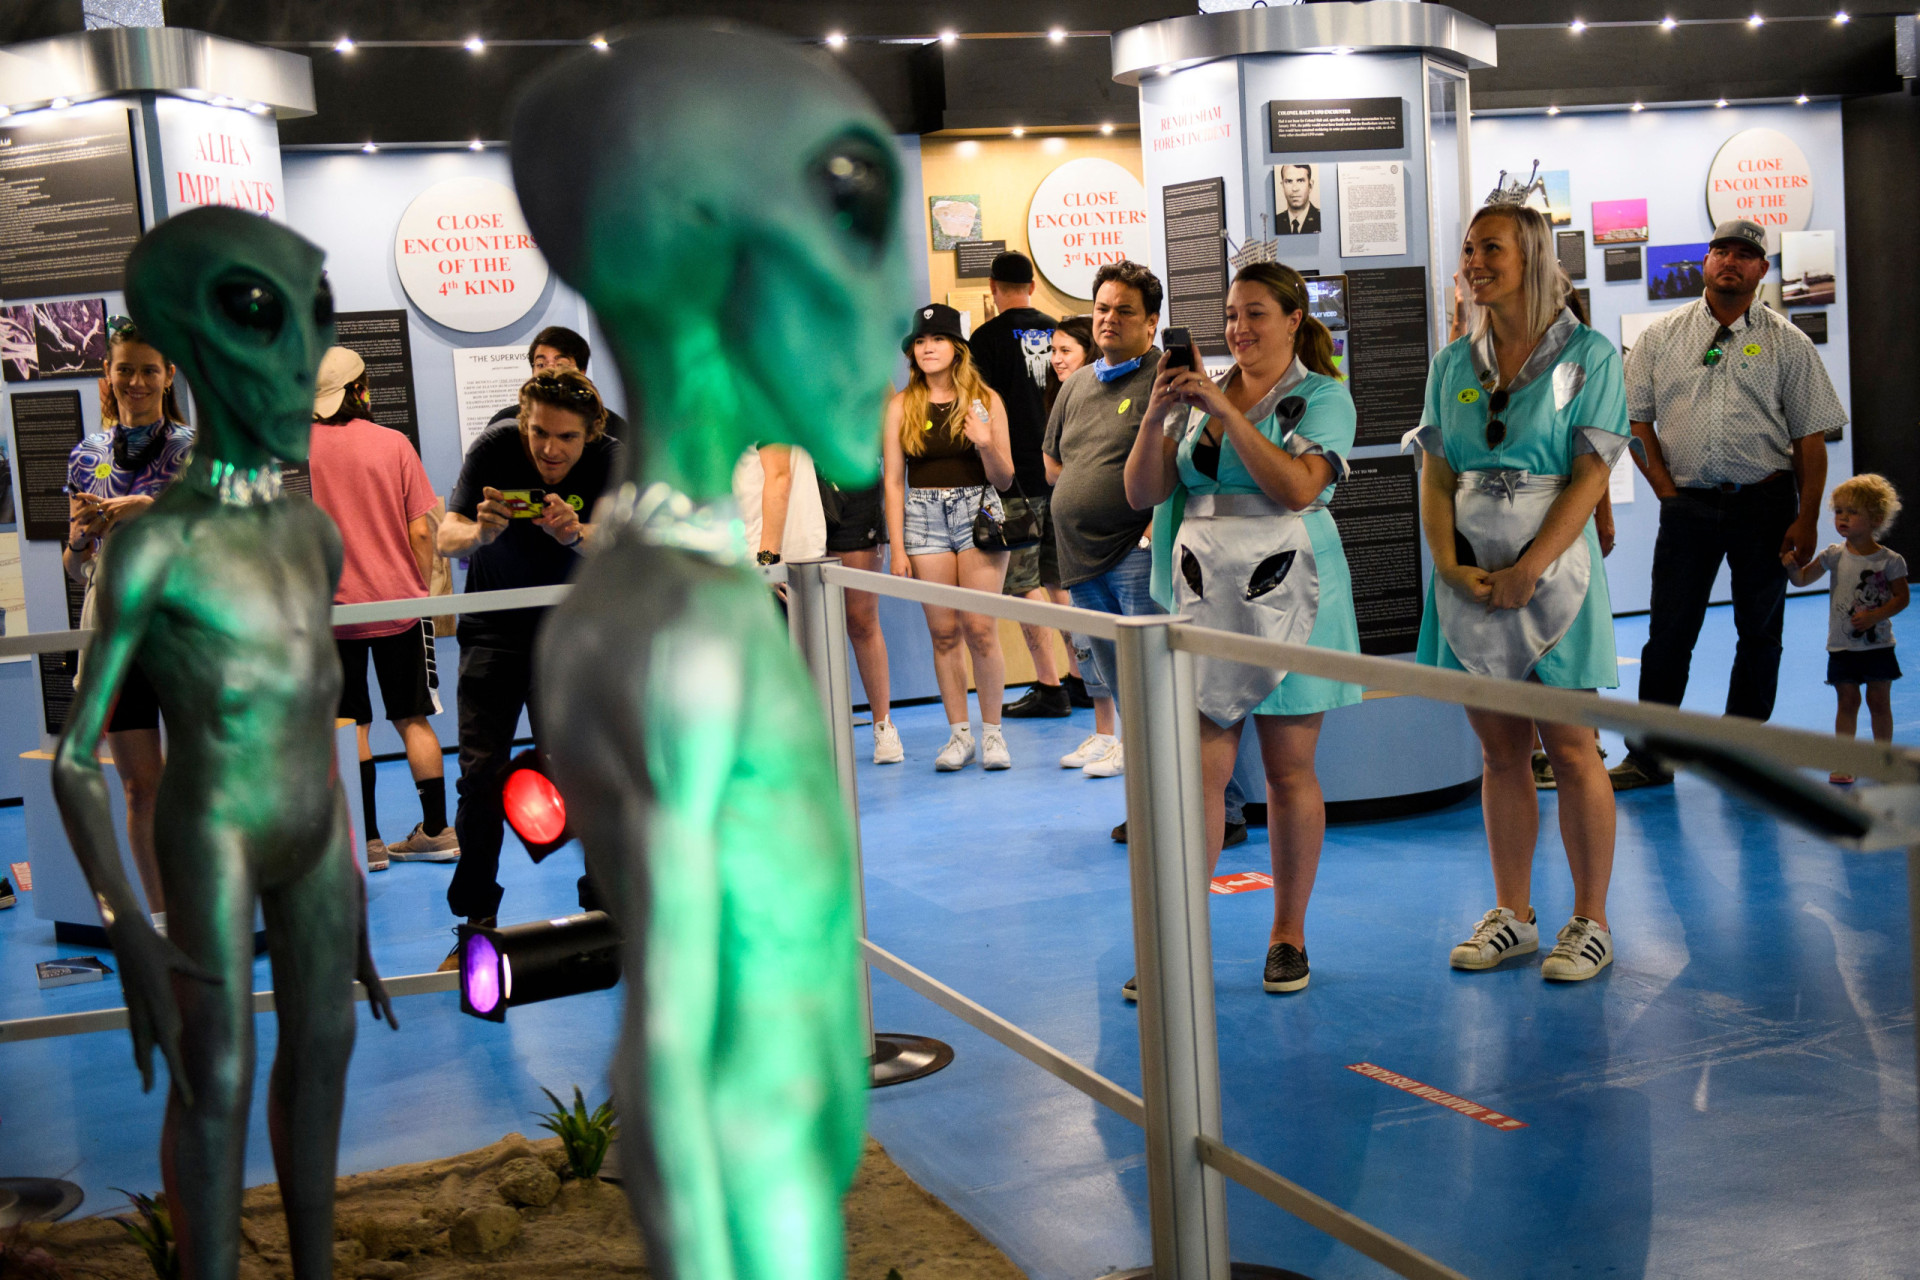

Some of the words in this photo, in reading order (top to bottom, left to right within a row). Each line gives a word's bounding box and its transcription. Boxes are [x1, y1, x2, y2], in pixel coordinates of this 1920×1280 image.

[196, 132, 251, 166] ALIEN
[1153, 133, 1185, 152] FOREST
[1738, 158, 1783, 173] CLOSE
[177, 172, 275, 212] IMPLANTS
[1714, 175, 1808, 192] ENCOUNTERS
[1064, 192, 1118, 207] CLOSE
[1736, 196, 1756, 210] OF
[1758, 194, 1786, 208] THE
[437, 213, 504, 231] CLOSE
[1036, 210, 1146, 228] ENCOUNTERS
[1753, 212, 1788, 226] KIND
[404, 234, 539, 254] ENCOUNTERS
[1063, 233, 1086, 247] OF
[1087, 231, 1124, 246] THE
[438, 259, 465, 274] OF
[469, 257, 511, 273] THE
[1063, 252, 1081, 268] 3rd
[1084, 251, 1126, 266] KIND
[438, 280, 458, 296] 4th
[465, 278, 515, 295] KIND
[1348, 1062, 1420, 1089] DISTANCE
[1410, 1085, 1487, 1114] MAINTAIN
